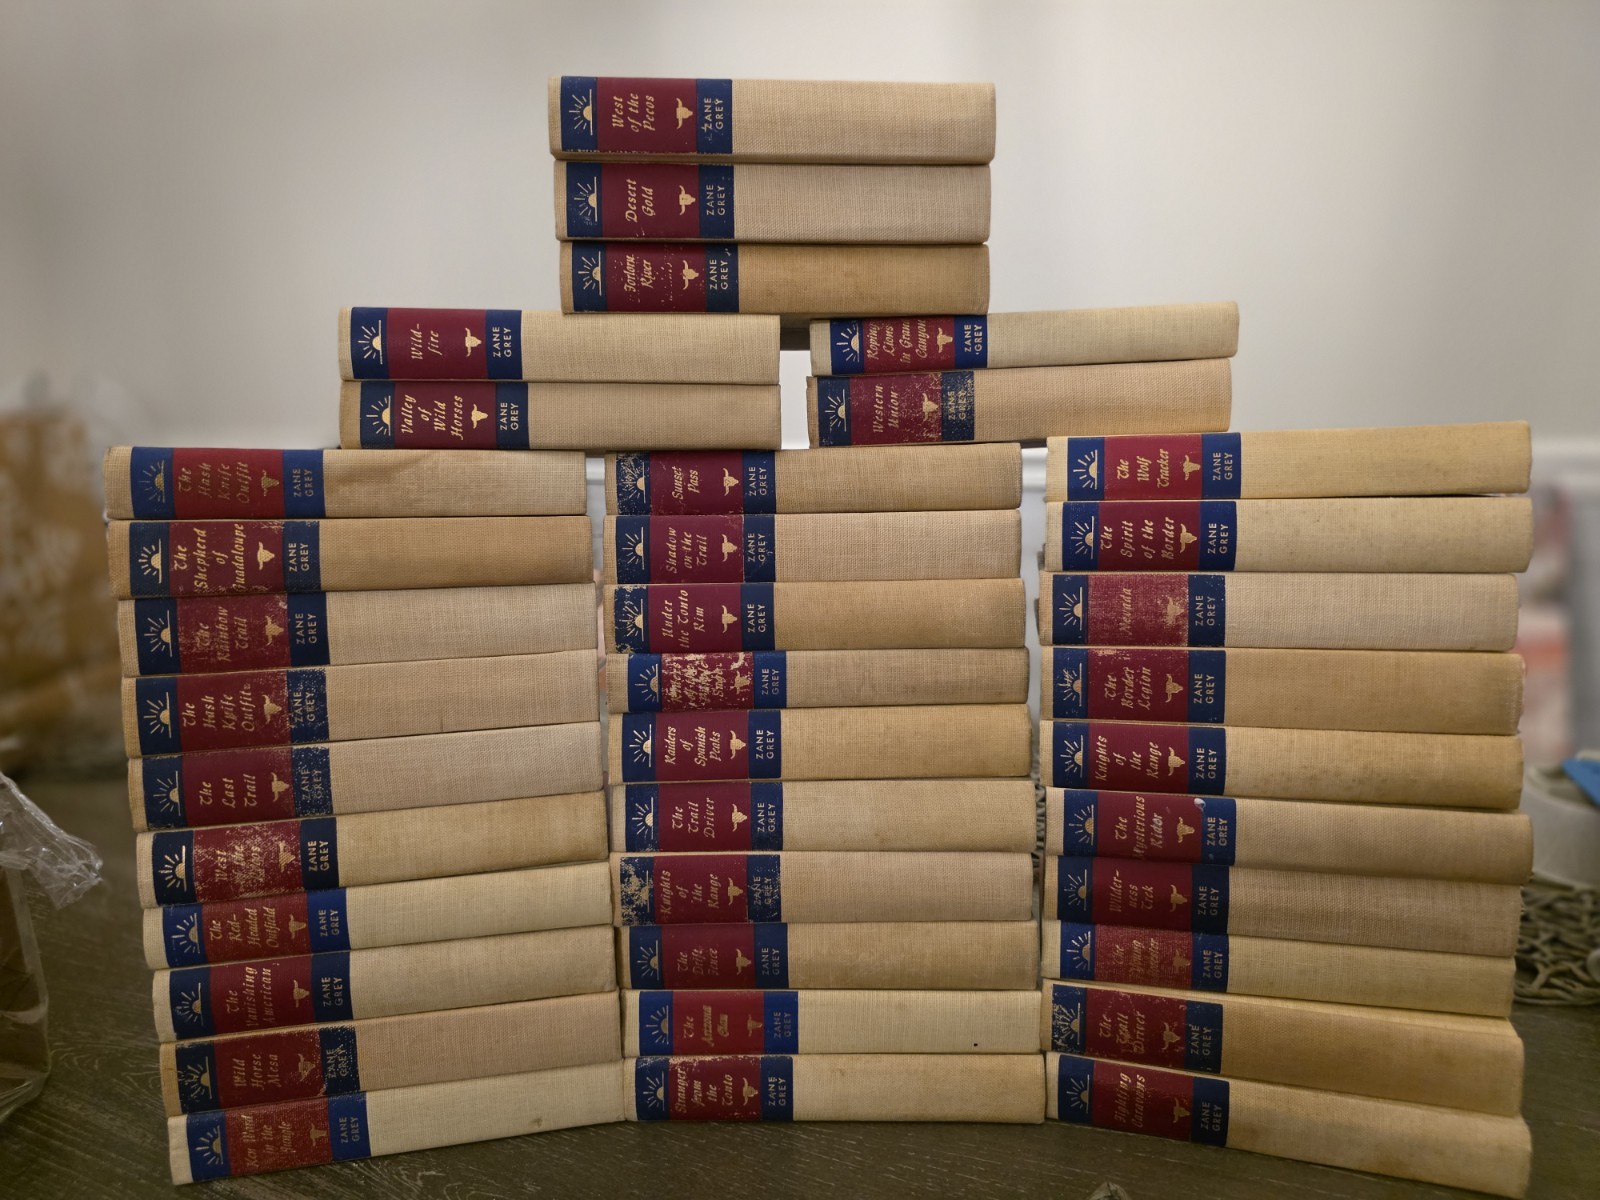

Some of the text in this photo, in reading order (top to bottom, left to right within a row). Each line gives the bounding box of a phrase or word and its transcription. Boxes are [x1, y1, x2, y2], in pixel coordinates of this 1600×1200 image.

[612, 96, 624, 128] West
[627, 93, 640, 132] of the
[643, 95, 654, 131] Pecos
[704, 98, 712, 130] ZANE
[715, 99, 723, 129] GREY
[626, 179, 637, 222] Desert
[642, 186, 656, 216] Gold
[706, 185, 714, 215] ZANE
[717, 185, 725, 215] GREY
[624, 255, 636, 292] Forlorn
[640, 260, 654, 288] River
[709, 259, 717, 290] ZANE
[720, 260, 728, 289] GREY
[411, 323, 423, 359] Wild-
[428, 330, 442, 355] fire
[493, 326, 501, 357] ZANE
[504, 327, 512, 357] GREY
[867, 324, 880, 359] Roping
[884, 326, 895, 356] Lions
[915, 320, 929, 358] Canyon
[401, 394, 415, 434] Valley
[418, 407, 432, 421] of
[434, 402, 446, 431] Wild
[451, 395, 464, 440] Horses
[500, 402, 508, 430] ZANE
[873, 385, 883, 433] Western
[888, 391, 899, 428] Union
[179, 467, 192, 492] The
[1117, 459, 1129, 479] The
[1136, 456, 1152, 481] Wolf
[1156, 449, 1170, 488] Tracker
[1213, 452, 1221, 480] ZANE
[1224, 452, 1233, 479] GREY
[219, 463, 231, 500] Knife
[292, 468, 301, 497] ZANE
[304, 469, 313, 496] GREY
[672, 466, 684, 500] Sunset
[688, 470, 700, 493] Pass
[748, 466, 756, 496] ZANE
[759, 467, 767, 495] GREY
[665, 527, 677, 573] Shadow
[682, 532, 692, 568] on the
[696, 535, 707, 566] Trail
[747, 533, 755, 562] ZANE
[1100, 526, 1112, 550] The
[1120, 520, 1135, 558] Spirit
[1141, 520, 1155, 559] of the
[1161, 516, 1174, 559] Border
[1208, 523, 1216, 553] ZANE
[1219, 524, 1229, 553] GREY
[174, 545, 187, 570] The
[193, 527, 210, 588] Shepherd
[212, 550, 228, 564] of
[289, 543, 297, 572] ZANE
[300, 543, 309, 571] GREY
[662, 600, 674, 637] Under
[677, 590, 689, 648] the Tonto
[694, 607, 705, 632] Rim
[747, 604, 755, 633] ZANE
[757, 604, 766, 632] GREY
[1195, 595, 1203, 626] ZANE
[1207, 596, 1215, 626] GREY
[295, 613, 304, 644] ZANE
[308, 613, 317, 643] GREY
[761, 668, 769, 695] ZANE
[771, 669, 779, 695] GREY
[1104, 675, 1117, 698] The
[1122, 666, 1134, 708] Border
[1138, 666, 1152, 710] Legion
[1194, 673, 1202, 703] ZANE
[1205, 675, 1214, 703] GREY
[182, 703, 196, 727] The
[201, 695, 216, 728] Hash
[239, 690, 256, 731] Outfit
[665, 726, 677, 764] Raiders
[681, 739, 693, 751] of
[695, 726, 708, 766] Spanish
[709, 731, 722, 761] Peaks
[766, 730, 774, 758] GREY
[1095, 736, 1109, 781] Knights
[1113, 753, 1127, 766] of
[1130, 751, 1142, 770] the
[1147, 742, 1163, 778] Range
[1196, 747, 1204, 778] ZANE
[1208, 749, 1216, 778] GREY
[200, 781, 212, 805] The
[222, 778, 236, 808] Last
[243, 773, 257, 808] Trail
[672, 806, 683, 829] The
[687, 801, 699, 833] Trail
[703, 798, 715, 838] Driver
[1115, 816, 1127, 840] The
[1134, 796, 1147, 858] Mysterious
[1207, 817, 1215, 846] ZANE
[1219, 818, 1227, 846] GREY
[308, 840, 317, 871] ZANE
[319, 840, 329, 870] GREY
[660, 870, 674, 914] Knights
[676, 885, 690, 898] of
[692, 884, 703, 901] the
[707, 874, 723, 908] Range
[1129, 884, 1139, 908] ness
[1142, 885, 1154, 910] Trek
[1198, 886, 1207, 915] ZANE
[1209, 888, 1219, 915] GREY
[210, 920, 222, 940] The
[245, 908, 261, 947] Headed
[318, 909, 327, 936] ZANE
[330, 909, 339, 935] GREY
[677, 951, 688, 971] The
[761, 947, 769, 975] ZANE
[772, 948, 780, 975] GREY
[1203, 950, 1211, 978] ZANE
[1214, 951, 1223, 978] GREY
[227, 990, 238, 1013] The
[243, 966, 258, 1026] Vanishing
[260, 968, 275, 1023] American
[321, 977, 331, 1006] ZANE
[333, 977, 343, 1005] GREY
[683, 1016, 694, 1038] The
[1099, 1013, 1112, 1037] The
[1190, 1025, 1199, 1055] ZANE
[1202, 1027, 1211, 1055] GREY
[233, 1059, 246, 1088] Wild
[251, 1054, 264, 1089] Horse
[266, 1054, 282, 1087] Mesa
[675, 1068, 688, 1113] Stranger
[692, 1080, 706, 1106] from
[707, 1084, 717, 1102] the
[721, 1074, 733, 1106] Tonto
[768, 1076, 776, 1106] ZANE
[778, 1077, 786, 1106] GREY
[1114, 1072, 1132, 1123] Fighting
[339, 1117, 348, 1143] ZANE
[350, 1117, 359, 1141] GREY
[1201, 1102, 1210, 1130] ZANE
[1212, 1105, 1222, 1131] GREY
